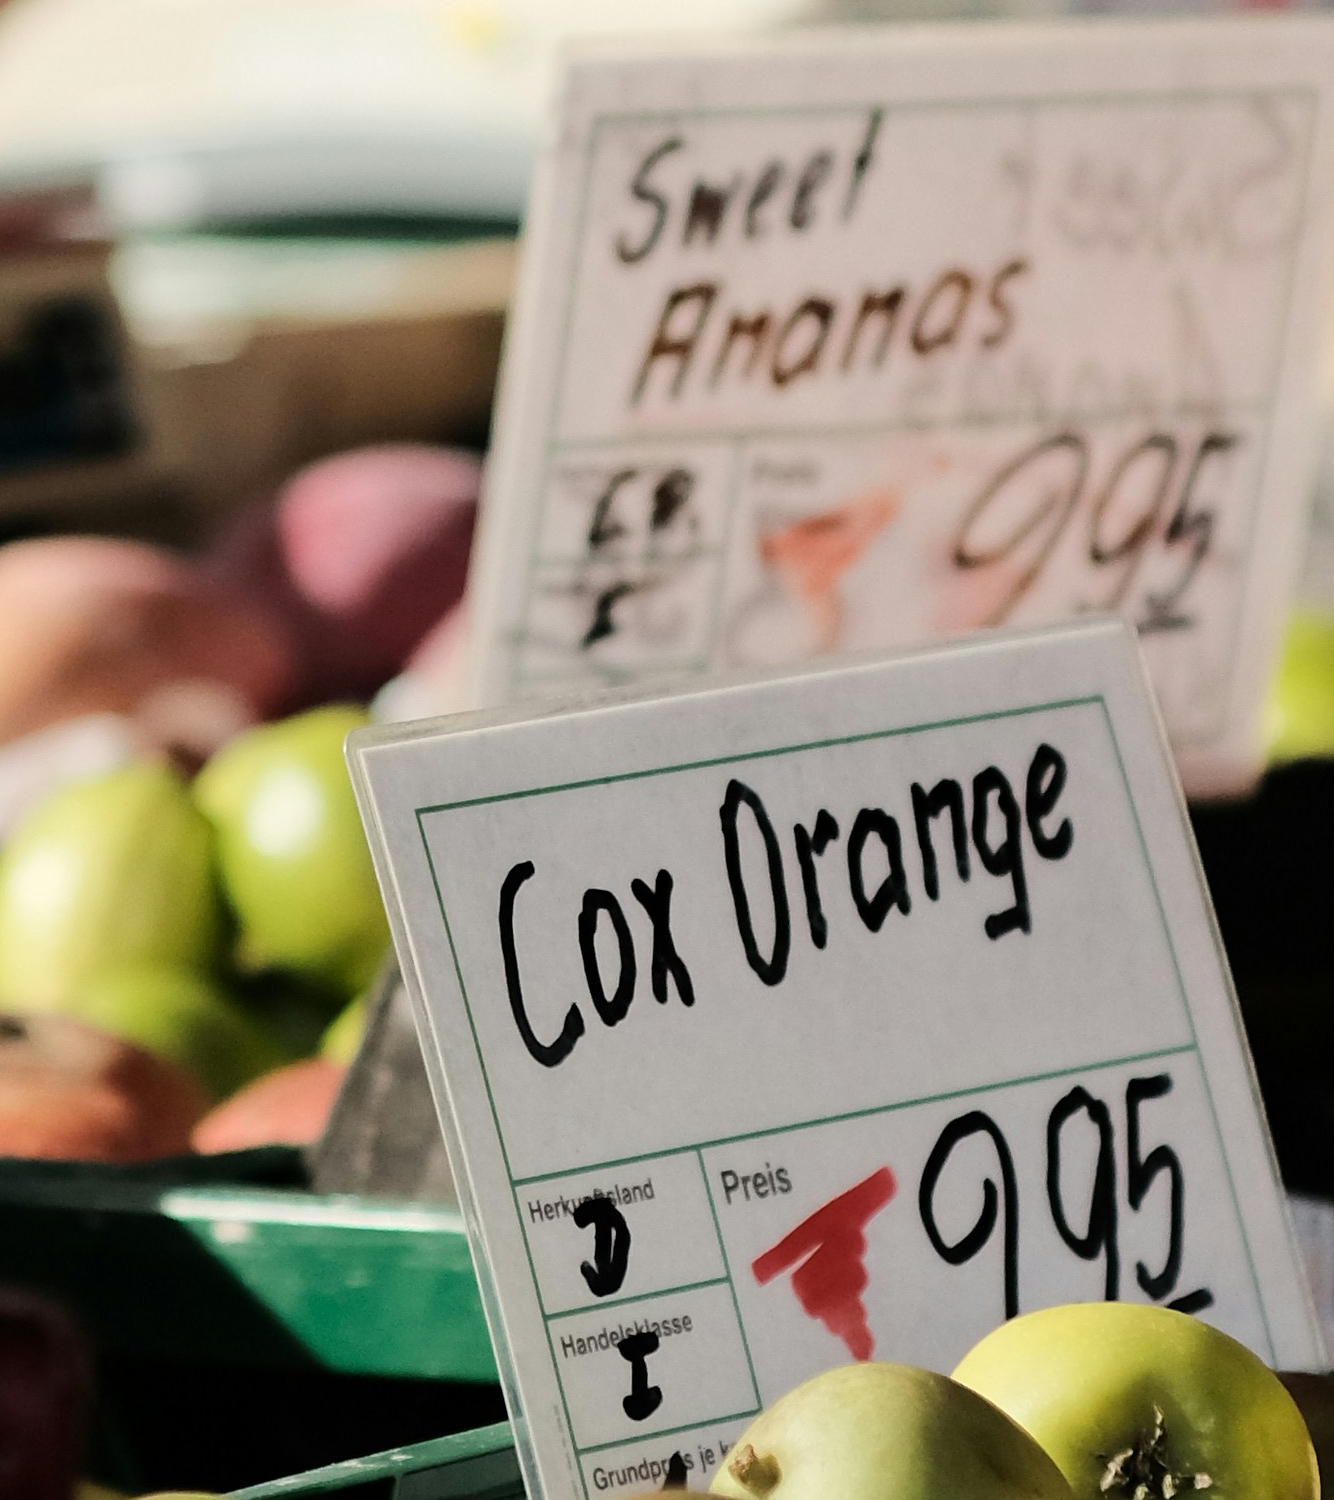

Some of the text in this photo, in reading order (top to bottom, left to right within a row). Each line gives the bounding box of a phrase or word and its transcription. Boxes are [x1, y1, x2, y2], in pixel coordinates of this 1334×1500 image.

[612, 108, 884, 268] Sweet
[628, 257, 1031, 414] Ananas
[498, 742, 1074, 1069] Cox Orange
[720, 1162, 793, 1205] Preis
[697, 1444, 716, 1474] je
